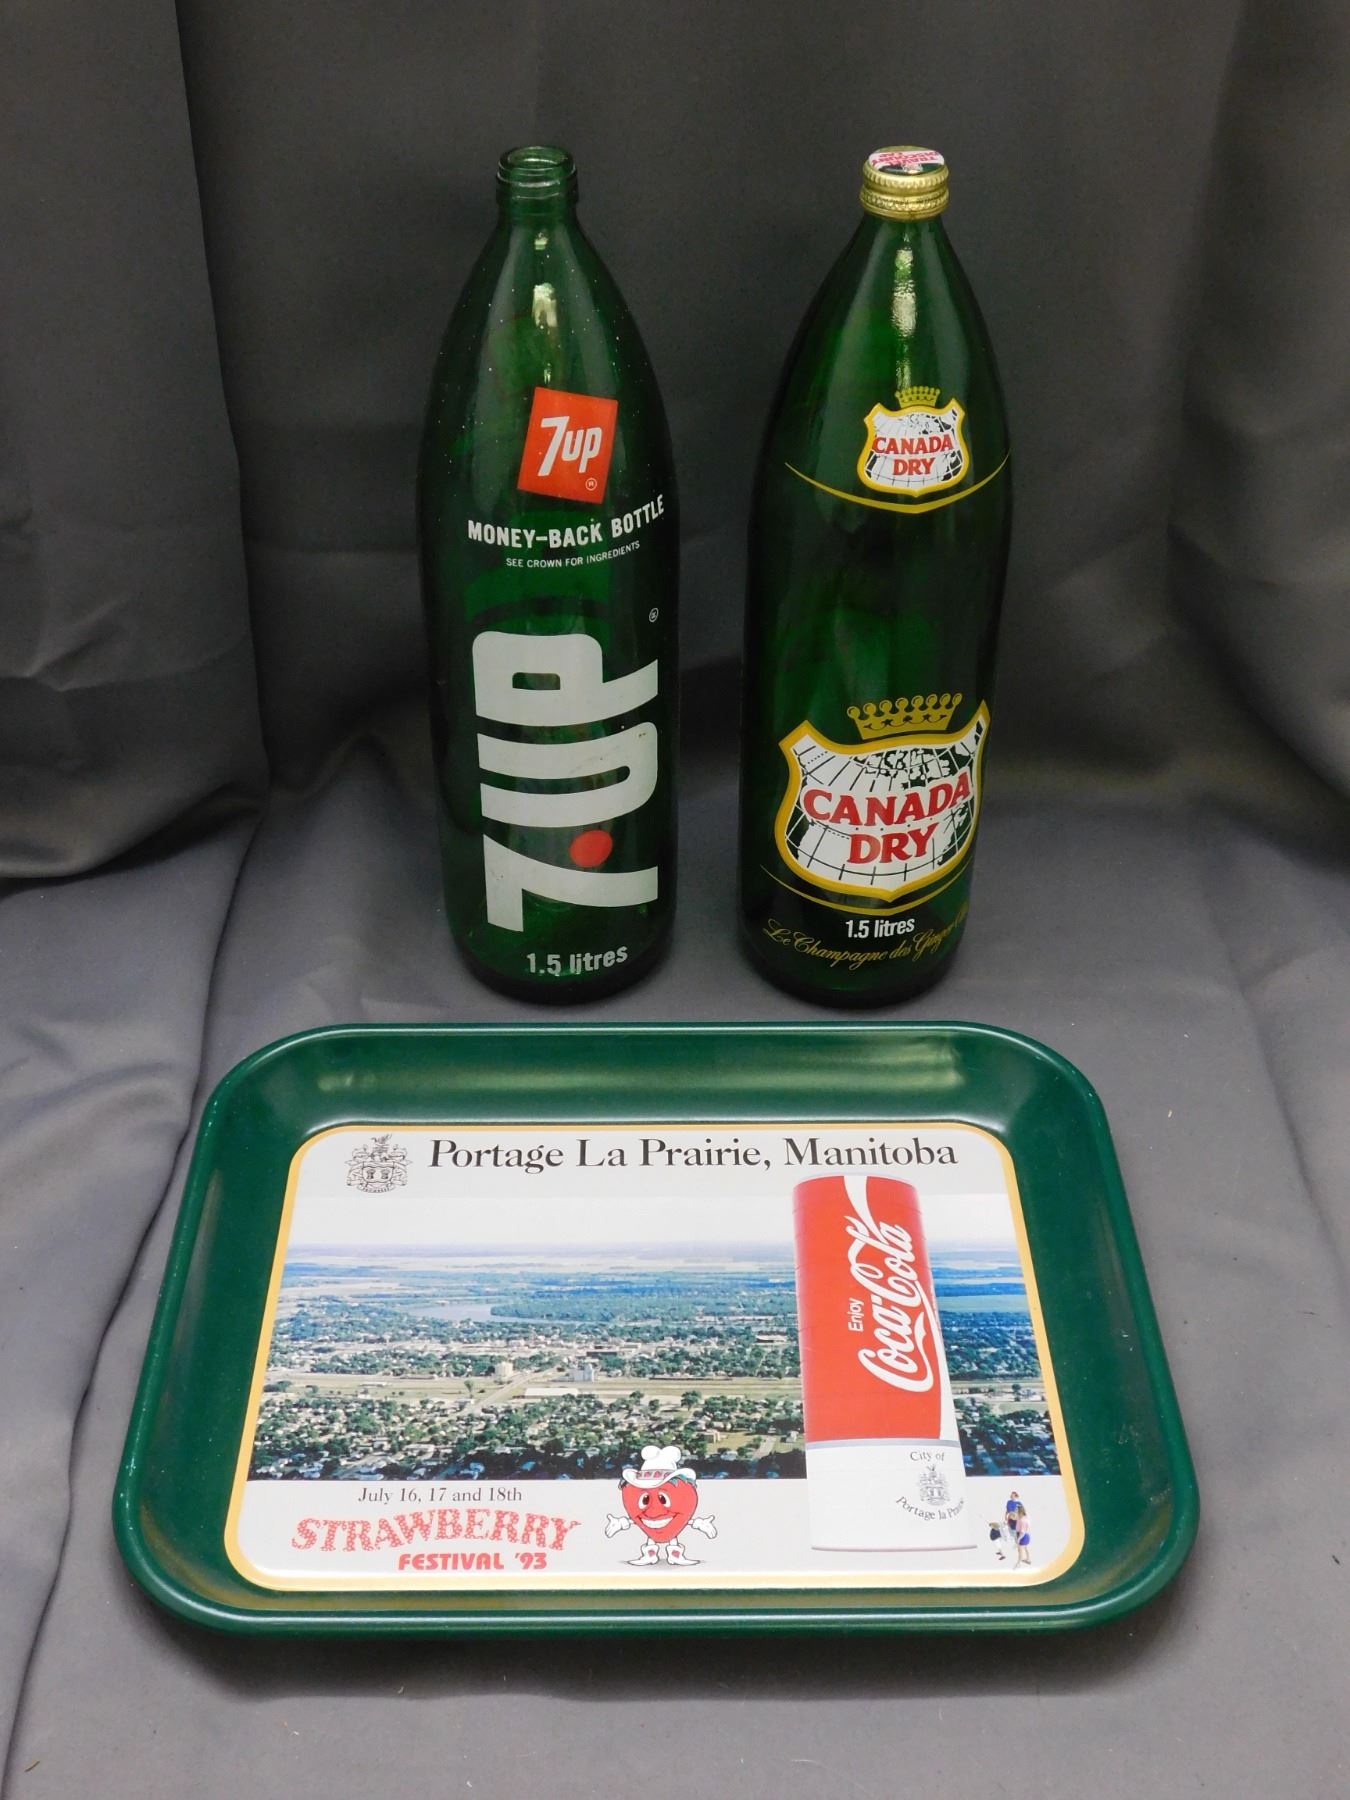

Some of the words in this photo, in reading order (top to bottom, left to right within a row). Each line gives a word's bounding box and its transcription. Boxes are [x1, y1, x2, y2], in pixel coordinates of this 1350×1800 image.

[871, 433, 954, 455] CANADA
[892, 457, 936, 476] DRY
[468, 519, 603, 549] MONEY-BACK
[611, 494, 665, 539] BOTTLE
[506, 557, 524, 568] SEE
[526, 559, 562, 568] CROWN
[565, 556, 584, 567] FOR
[586, 540, 641, 564] INGREDIENTS
[802, 771, 971, 827] CANADA
[846, 822, 940, 865] DRY
[845, 919, 870, 939] 1.5
[873, 918, 915, 937] litres
[763, 918, 791, 946] Le
[792, 931, 888, 971] Champagne
[889, 939, 912, 959] des
[526, 952, 562, 977] 1.5
[569, 946, 628, 975] litres
[428, 1139, 564, 1174] Portage
[576, 1138, 628, 1167] La
[639, 1138, 771, 1171] Prairie,
[782, 1137, 959, 1167] Manitoba
[844, 1215, 934, 1393] Coca-Cola
[848, 1297, 865, 1332] Enjoy
[909, 1451, 932, 1462] City
[935, 1452, 945, 1461] of
[358, 1487, 394, 1505] July
[399, 1487, 423, 1503] 16,
[428, 1487, 448, 1502] 17
[452, 1487, 482, 1502] and
[488, 1487, 523, 1502] 18th
[895, 1496, 936, 1521] Portage
[291, 1508, 582, 1552] STRAWBERRY
[398, 1553, 505, 1571] FESTIVAL
[514, 1552, 548, 1570] '93
